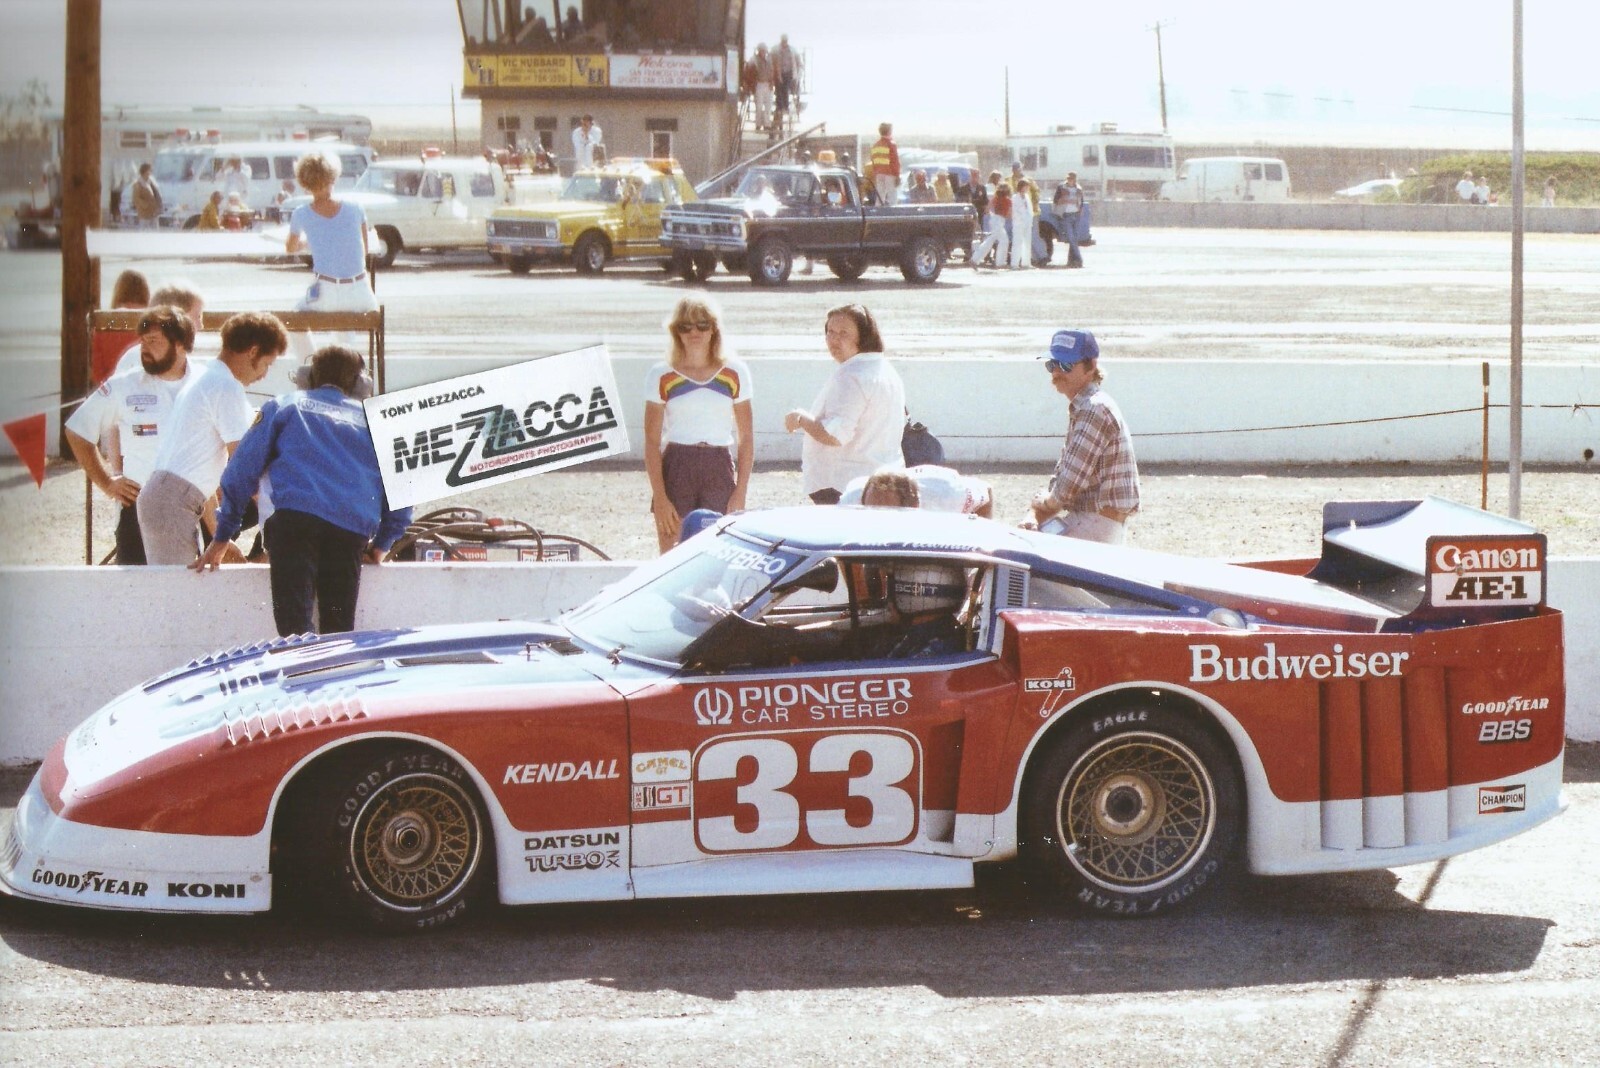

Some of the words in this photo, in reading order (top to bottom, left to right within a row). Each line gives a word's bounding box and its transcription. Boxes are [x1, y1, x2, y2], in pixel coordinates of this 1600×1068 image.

[502, 58, 517, 67] VIC
[520, 58, 566, 67] HUBBARD
[1435, 545, 1538, 572] Canon
[1446, 576, 1527, 600] AE-1
[1188, 643, 1410, 682] Budweiser
[739, 678, 914, 707] PIONEER
[1027, 679, 1073, 690] KONI
[742, 707, 789, 724] CAR
[809, 700, 909, 720] STEREO
[1462, 696, 1550, 716] GOODYEAR
[1092, 711, 1149, 733] EAGLE
[1478, 719, 1532, 744] BBS
[502, 759, 620, 785] KENDALL
[635, 757, 688, 773] CAMEL
[657, 785, 688, 804] GT
[697, 733, 916, 852] 33
[1481, 793, 1524, 805] CHAMPION
[524, 832, 620, 850] DATSUN
[525, 850, 605, 872] TURBO
[32, 869, 148, 897] GOODYEAR
[167, 882, 246, 898] KONI
